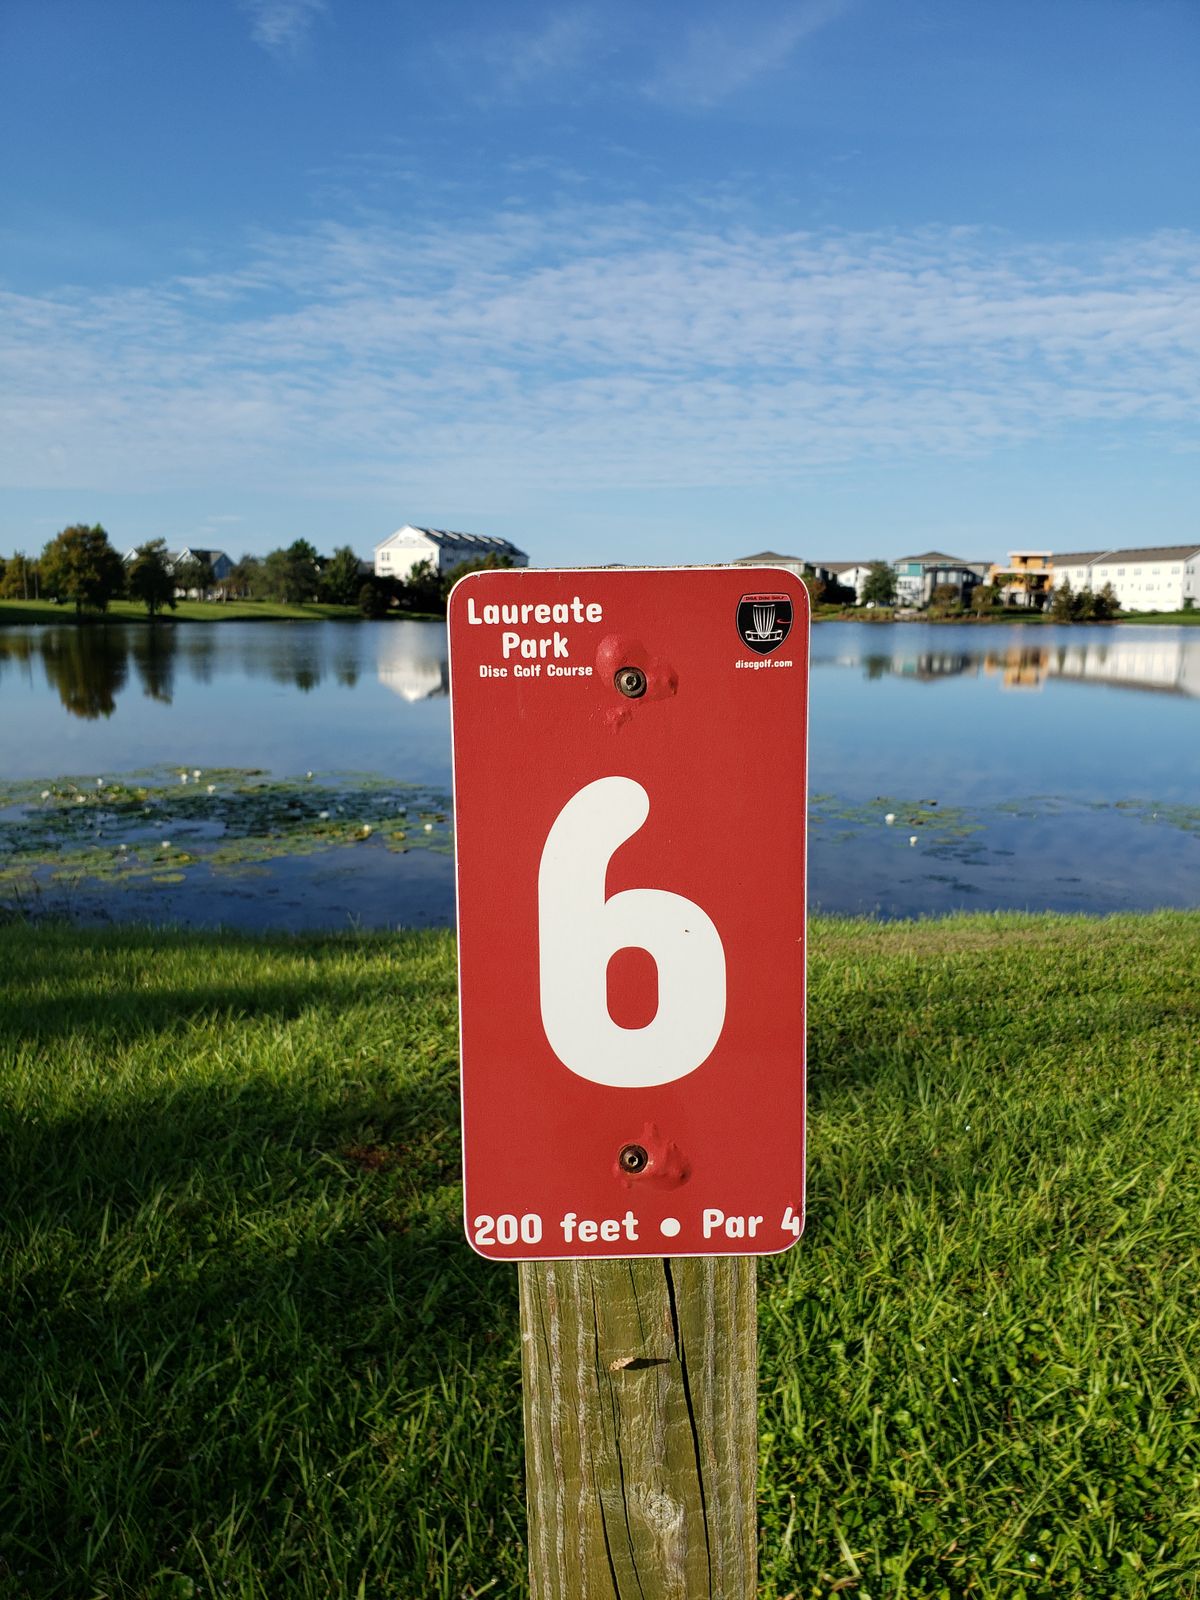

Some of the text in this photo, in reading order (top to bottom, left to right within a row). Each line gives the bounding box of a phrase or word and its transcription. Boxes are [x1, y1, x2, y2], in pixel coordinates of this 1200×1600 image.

[467, 596, 603, 625] Laureate
[502, 631, 569, 659] Park
[479, 663, 593, 678] Disc Golf Course
[735, 658, 793, 670] discgolf.com
[537, 775, 727, 1089] 6
[473, 1206, 800, 1246] 200 feet Par 4
